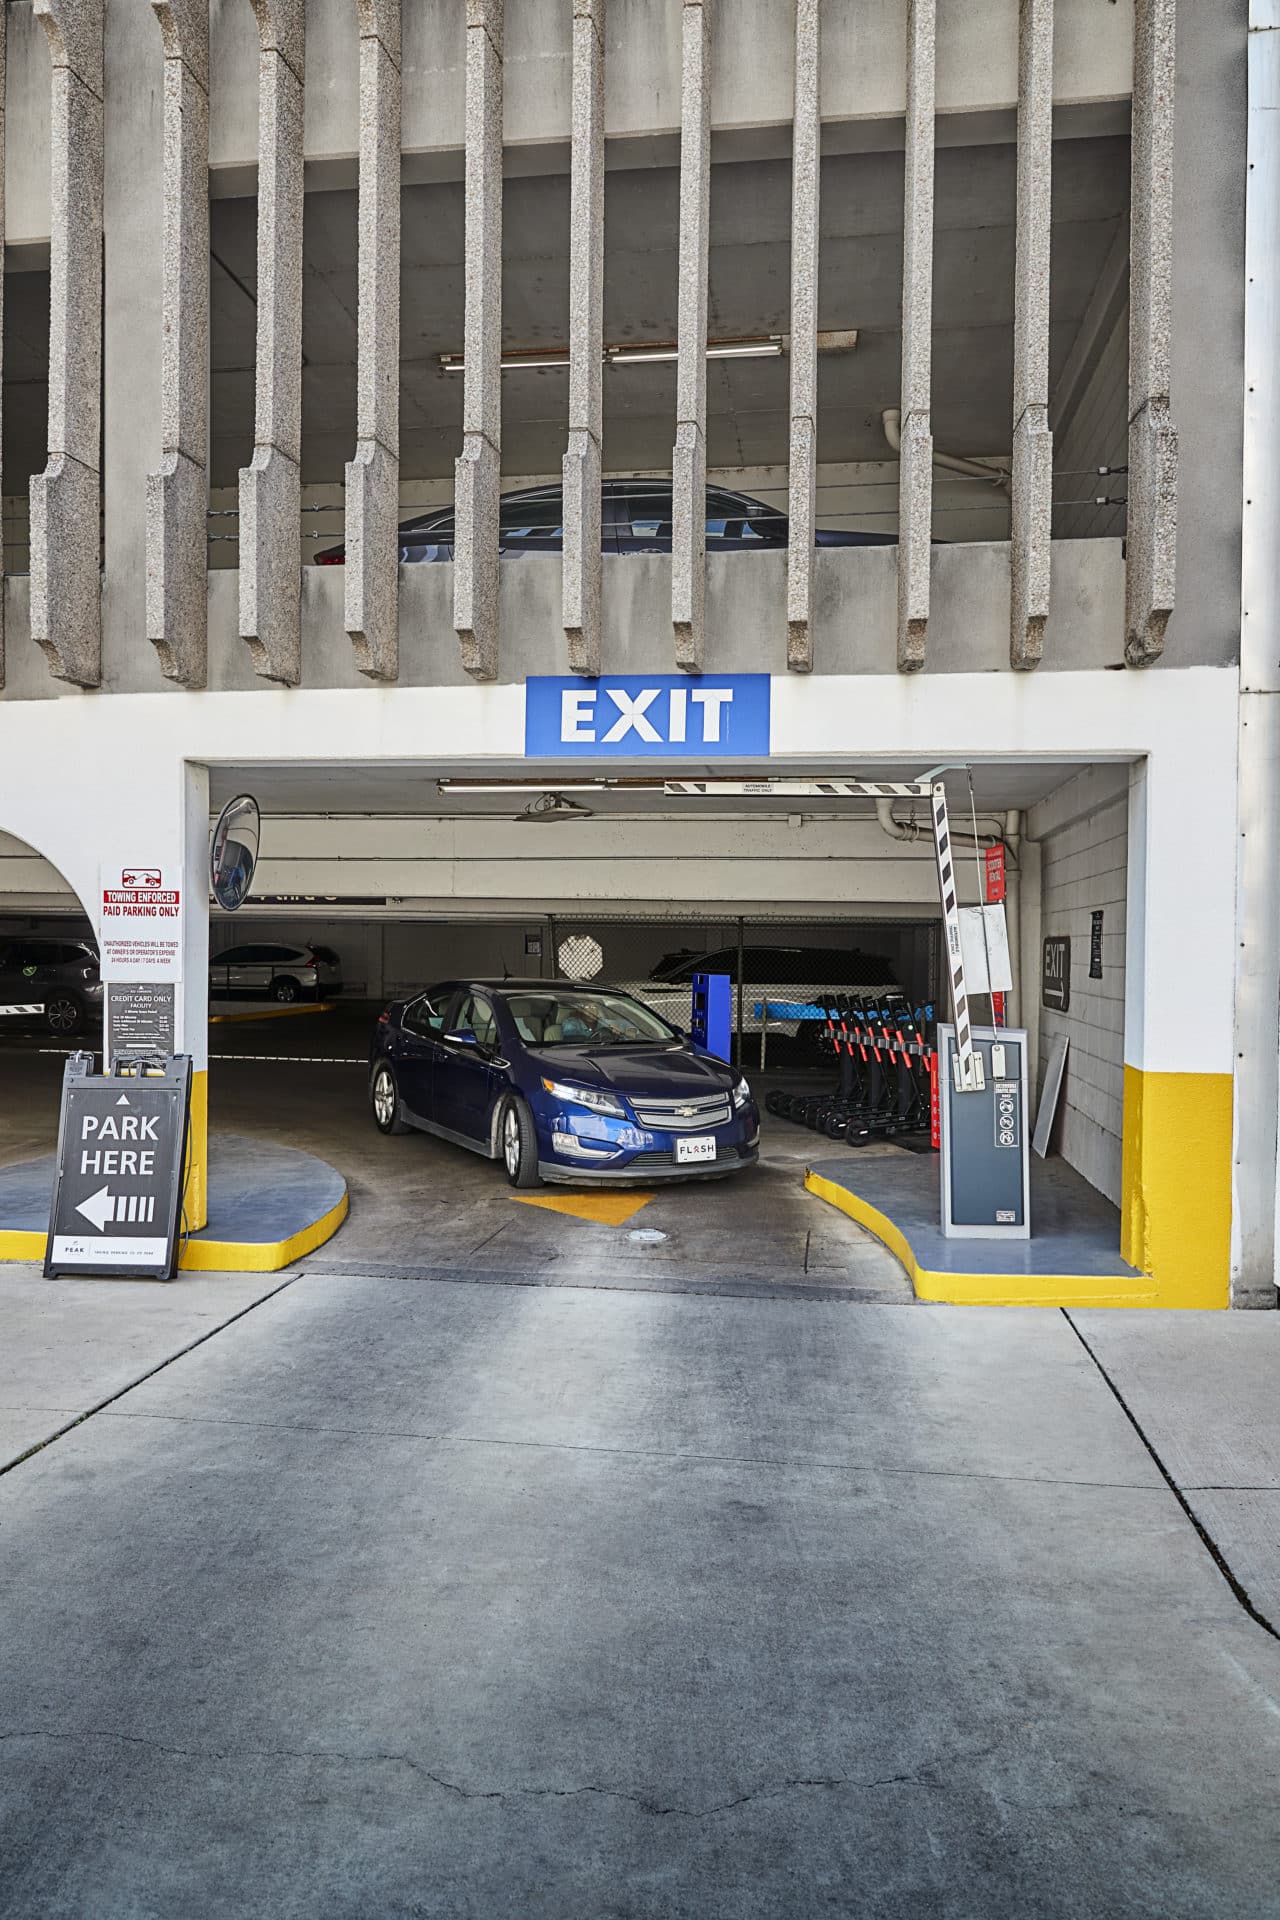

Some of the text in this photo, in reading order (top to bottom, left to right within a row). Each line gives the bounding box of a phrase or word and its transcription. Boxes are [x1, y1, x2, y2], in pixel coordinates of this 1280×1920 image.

[560, 688, 734, 743] EXIT
[107, 891, 176, 903] TOWING ENFORCED
[103, 906, 180, 917] PAID PARKING ONLY
[1045, 943, 1065, 978] EXIT
[81, 1115, 160, 1141] PARK
[80, 1150, 155, 1176] HERE
